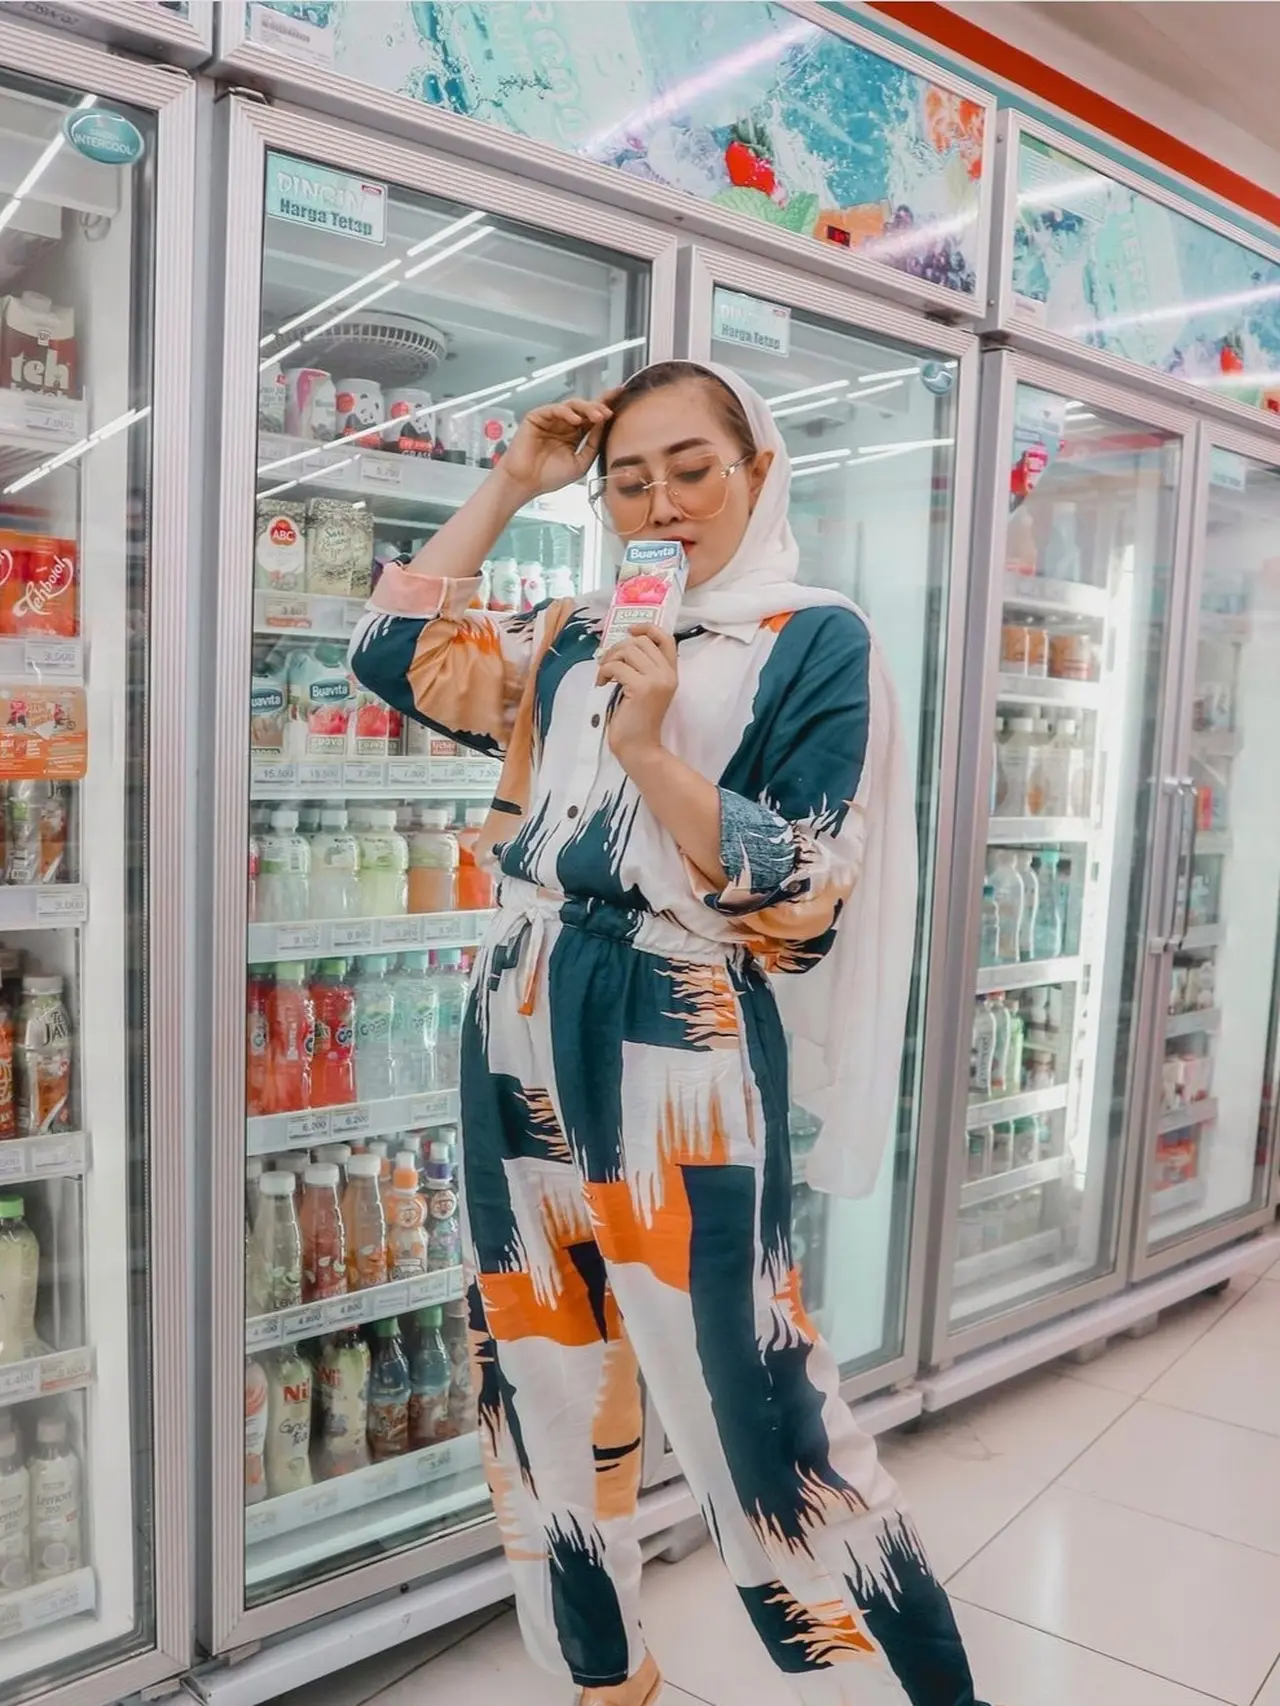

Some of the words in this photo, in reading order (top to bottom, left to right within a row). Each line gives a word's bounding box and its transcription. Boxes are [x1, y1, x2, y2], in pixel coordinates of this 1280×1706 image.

[280, 198, 327, 223] Harga
[330, 211, 373, 235] Tetap
[10, 348, 70, 390] teh
[271, 529, 297, 542] ABC
[630, 546, 675, 560] Buavita
[13, 554, 73, 617] Tehbotol
[312, 684, 348, 697] Buavita
[252, 694, 281, 707] uavita
